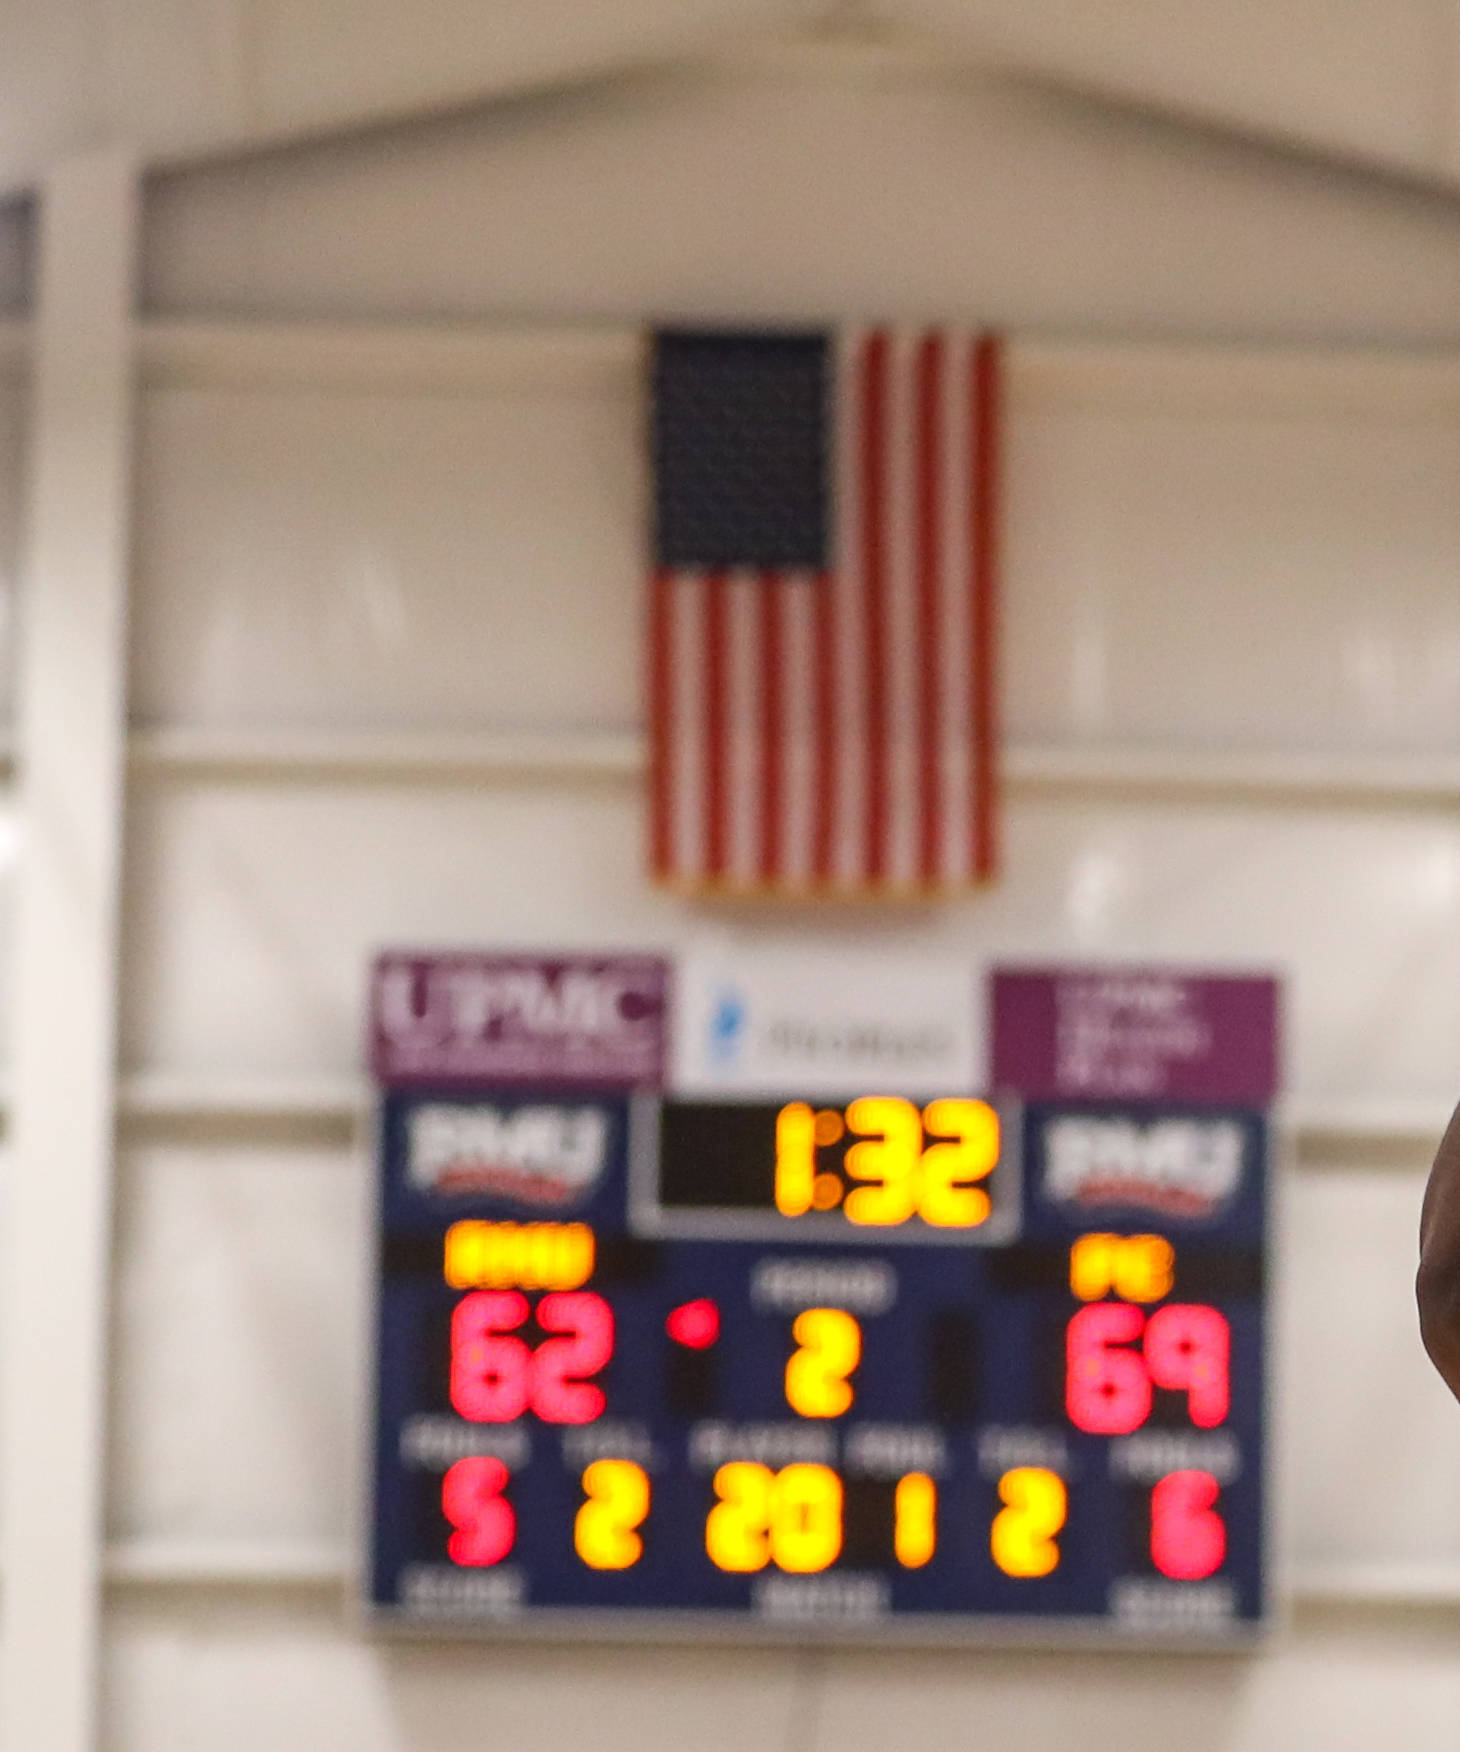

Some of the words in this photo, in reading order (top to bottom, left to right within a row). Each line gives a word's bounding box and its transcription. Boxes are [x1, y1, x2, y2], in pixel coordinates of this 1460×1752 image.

[775, 1096, 1000, 1228] 1:32
[450, 1291, 614, 1424] 62
[785, 1308, 861, 1418] 2
[1066, 1303, 1231, 1435] 69
[442, 1456, 516, 1568] 5
[574, 1459, 650, 1571] 2
[706, 1461, 843, 1573] 20
[894, 1471, 937, 1569] 1
[991, 1467, 1067, 1578] 2
[1150, 1469, 1227, 1580] 6
